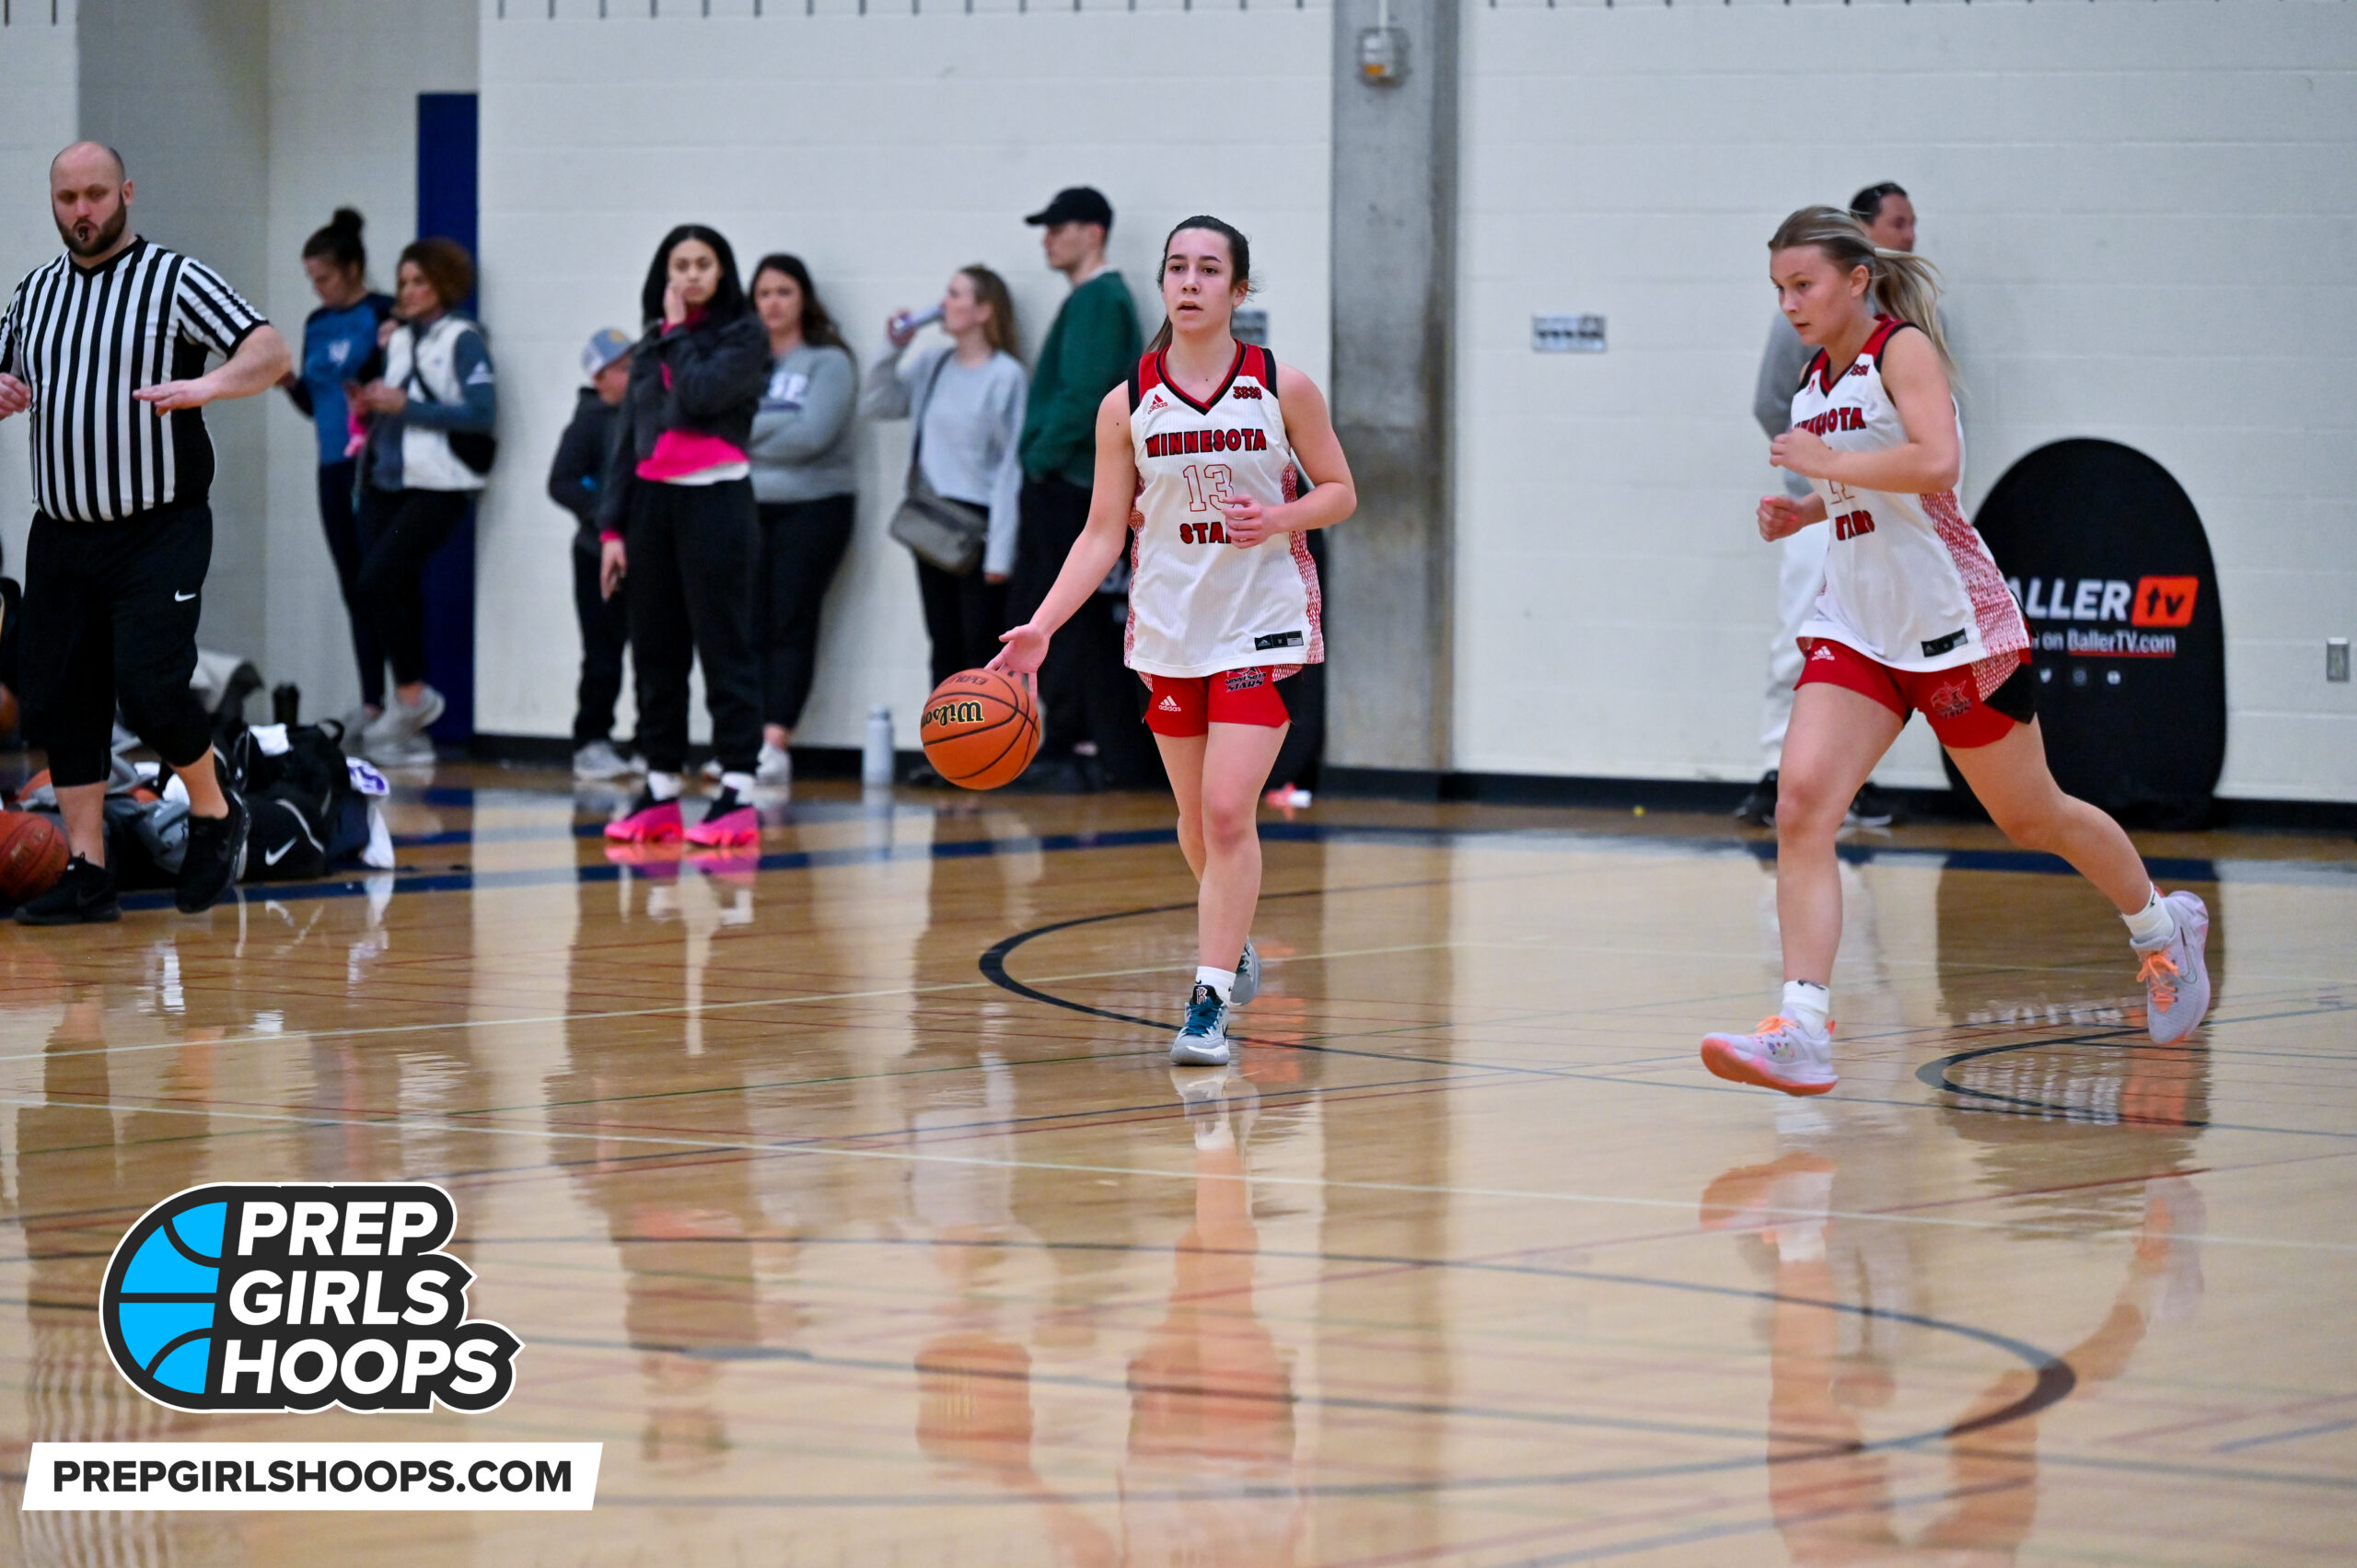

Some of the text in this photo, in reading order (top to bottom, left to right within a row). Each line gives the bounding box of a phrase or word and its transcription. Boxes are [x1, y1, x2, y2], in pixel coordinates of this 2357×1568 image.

[1145, 428, 1267, 458] MINNESOTA
[1183, 464, 1235, 512] 13
[1179, 522, 1231, 545] STA
[2007, 576, 2185, 621] ALLER tv
[2068, 628, 2177, 654] BallerTV.com
[922, 701, 984, 729] Wilson
[1158, 704, 1182, 713] adidas
